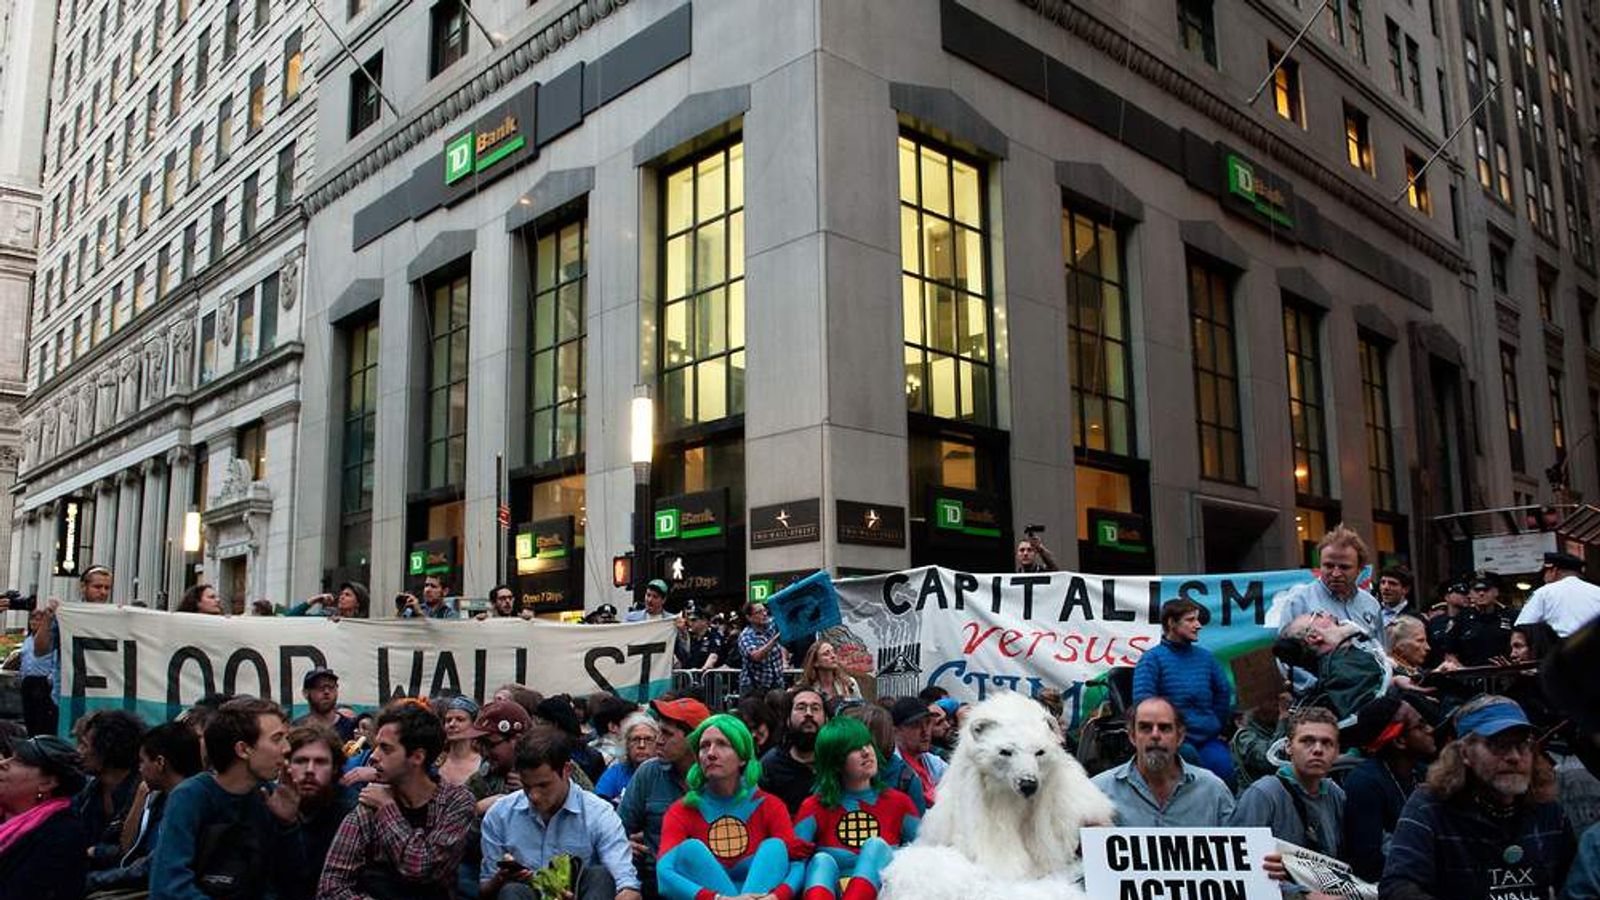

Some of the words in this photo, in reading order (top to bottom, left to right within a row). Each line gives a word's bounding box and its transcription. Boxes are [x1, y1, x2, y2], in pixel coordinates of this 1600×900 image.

[476, 114, 517, 152] Bank
[884, 568, 1265, 627] CAPITALISM
[962, 622, 1154, 666] versus
[584, 641, 667, 703] ST
[1106, 834, 1251, 872] CLIMATE
[1119, 879, 1247, 900] ACTION
[1487, 867, 1534, 886] TAX
